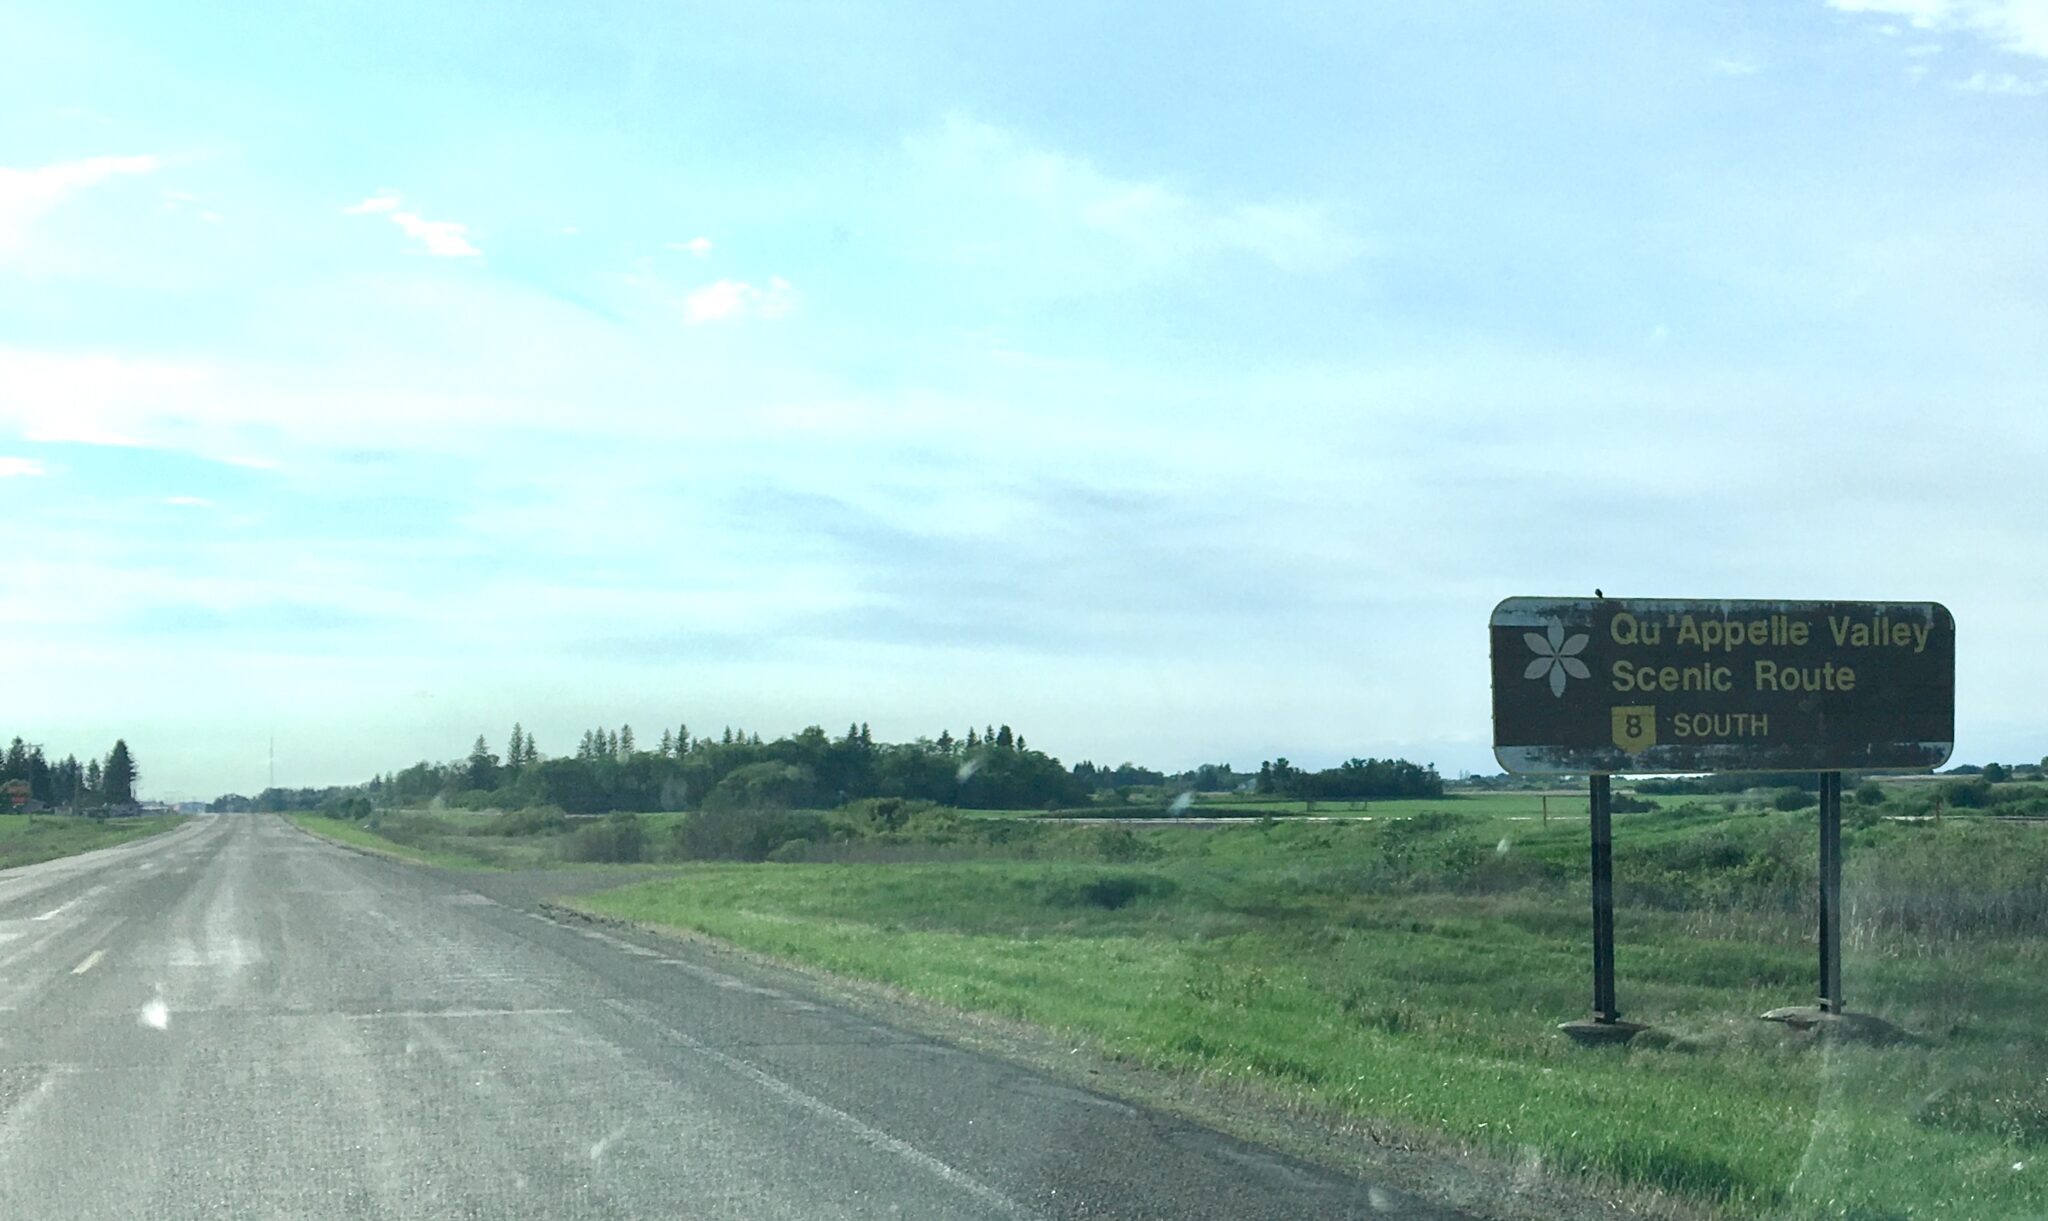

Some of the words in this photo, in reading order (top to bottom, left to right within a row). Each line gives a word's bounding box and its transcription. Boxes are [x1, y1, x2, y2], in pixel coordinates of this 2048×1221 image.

[1610, 612, 1809, 653] Qu'Appelle
[1829, 616, 1930, 653] Valley
[1611, 660, 1732, 692] Scenic
[1755, 660, 1856, 692] Route
[1625, 714, 1643, 739] 8
[1674, 714, 1769, 737] SOUTH
